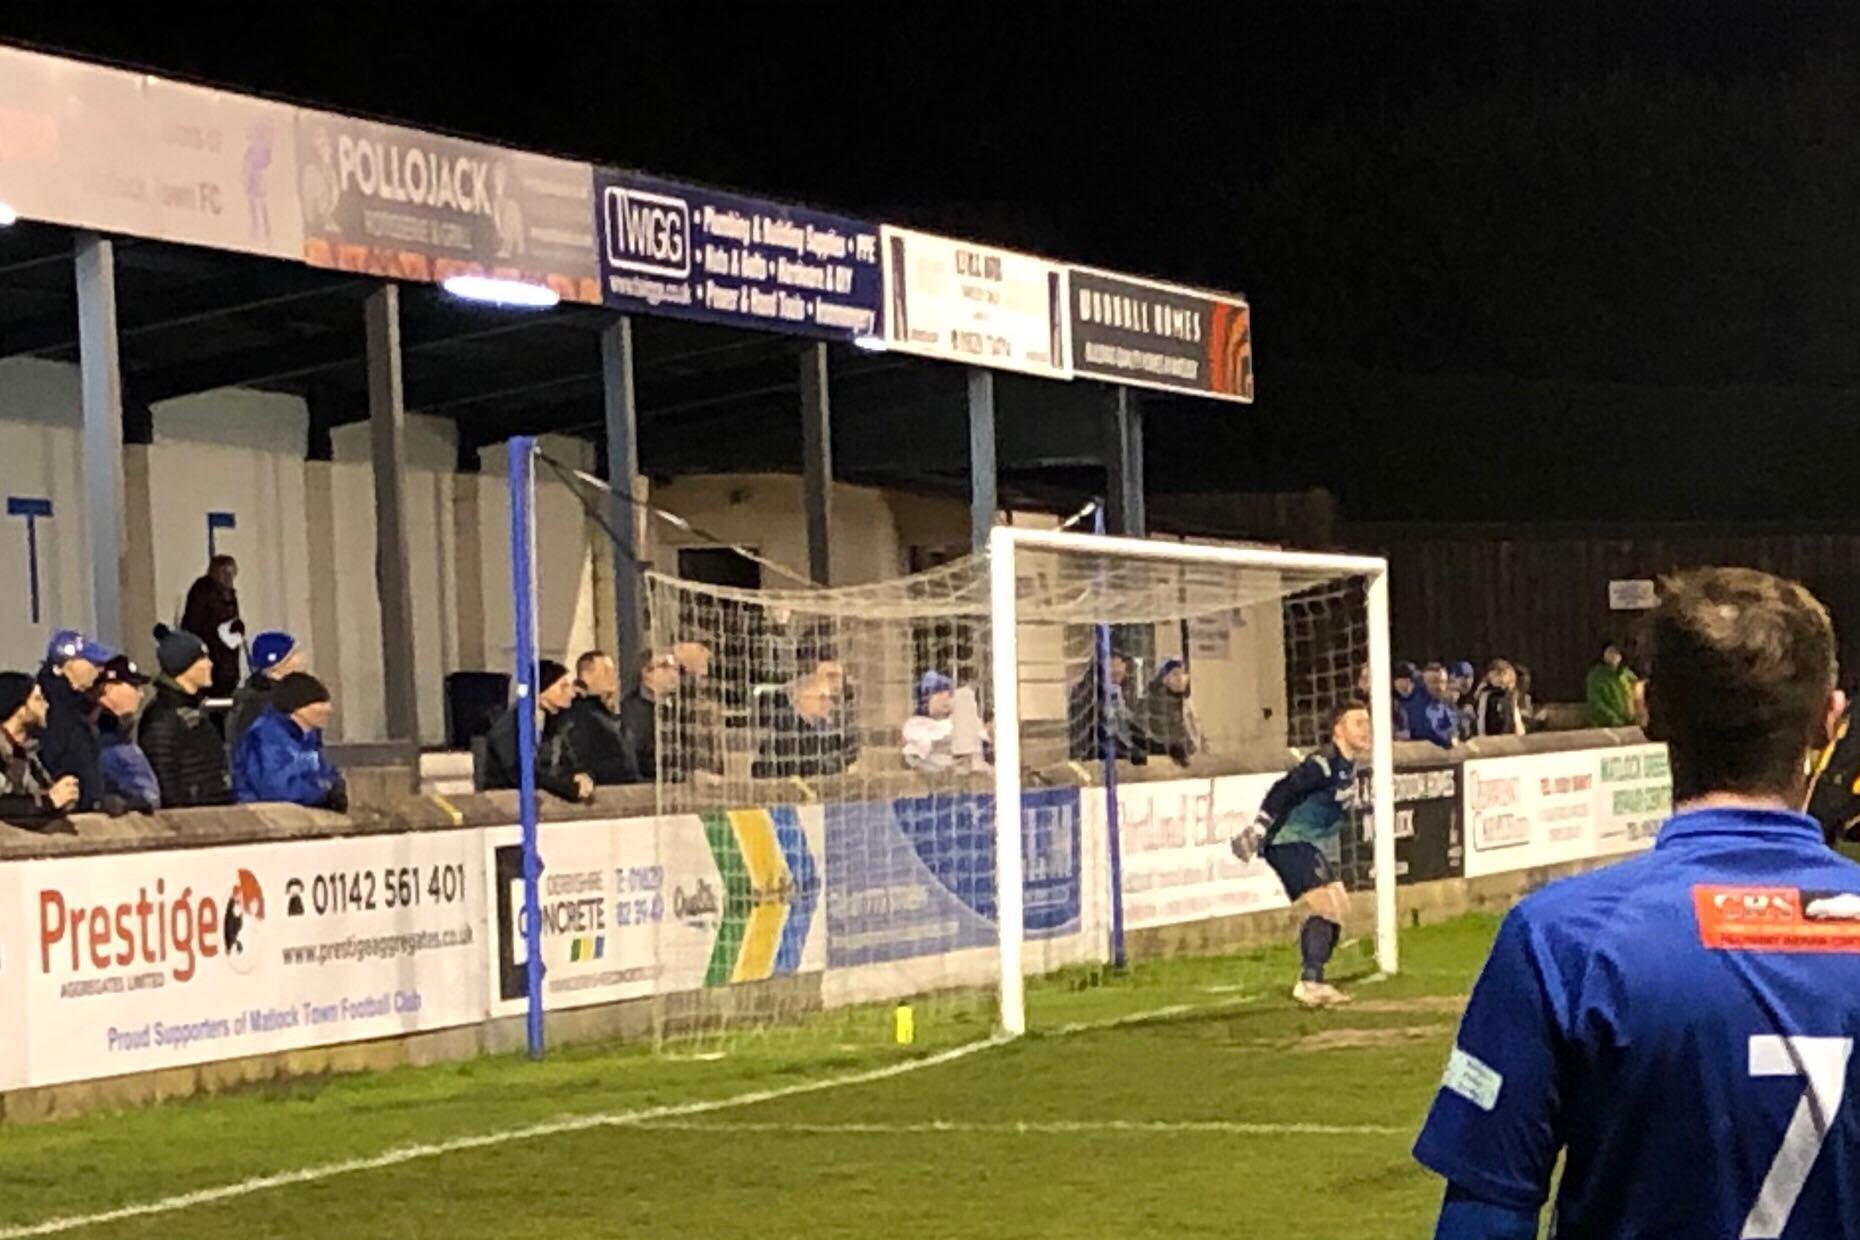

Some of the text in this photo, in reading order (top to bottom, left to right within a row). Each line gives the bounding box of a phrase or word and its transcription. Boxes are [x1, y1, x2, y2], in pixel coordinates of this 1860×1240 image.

[339, 134, 492, 216] POLLOJACK
[312, 863, 465, 916] 01142 561 401
[517, 896, 606, 940] CNCRETE
[40, 877, 218, 982] Prestige
[107, 990, 421, 1052] Proud Supporters of Matlock Town Football Club
[1740, 1034, 1854, 1240] 7
